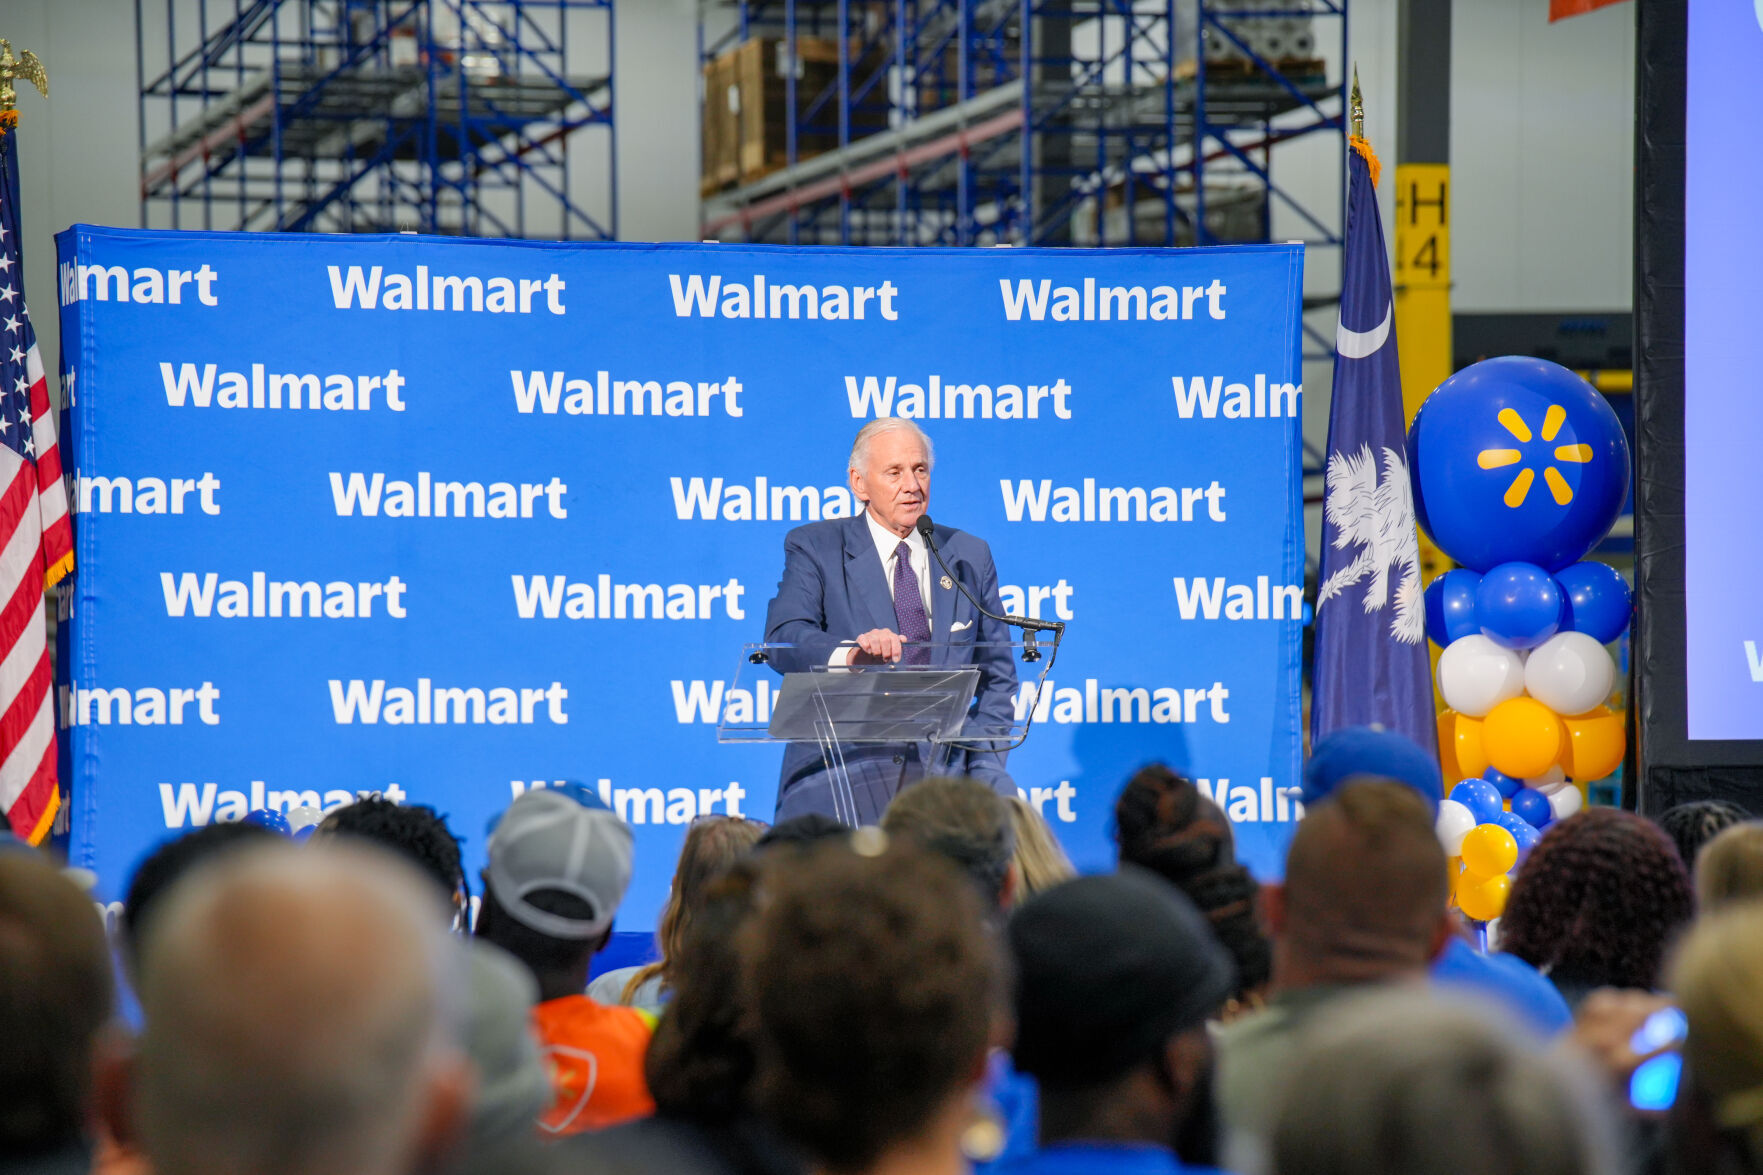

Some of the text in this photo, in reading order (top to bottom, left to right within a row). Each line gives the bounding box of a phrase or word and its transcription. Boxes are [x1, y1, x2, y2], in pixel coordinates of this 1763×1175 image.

[1411, 181, 1446, 226] H
[1413, 234, 1445, 277] 4
[60, 256, 218, 306] Walmart
[327, 265, 566, 315] Walmart
[669, 274, 899, 321] Walmart
[999, 277, 1227, 322] Walmart
[160, 362, 406, 411] Walmart
[511, 370, 744, 417] Walmart
[844, 375, 1072, 420] Walmart
[1172, 373, 1302, 419] Walm
[329, 472, 568, 519] Walmart
[670, 476, 866, 521] Walma
[1000, 478, 1227, 522] Walmart
[160, 572, 407, 618] Walmart
[512, 574, 746, 620] Walmart
[1173, 575, 1305, 620] Walm
[328, 678, 569, 725] Walmart
[1010, 678, 1230, 724] Walmart
